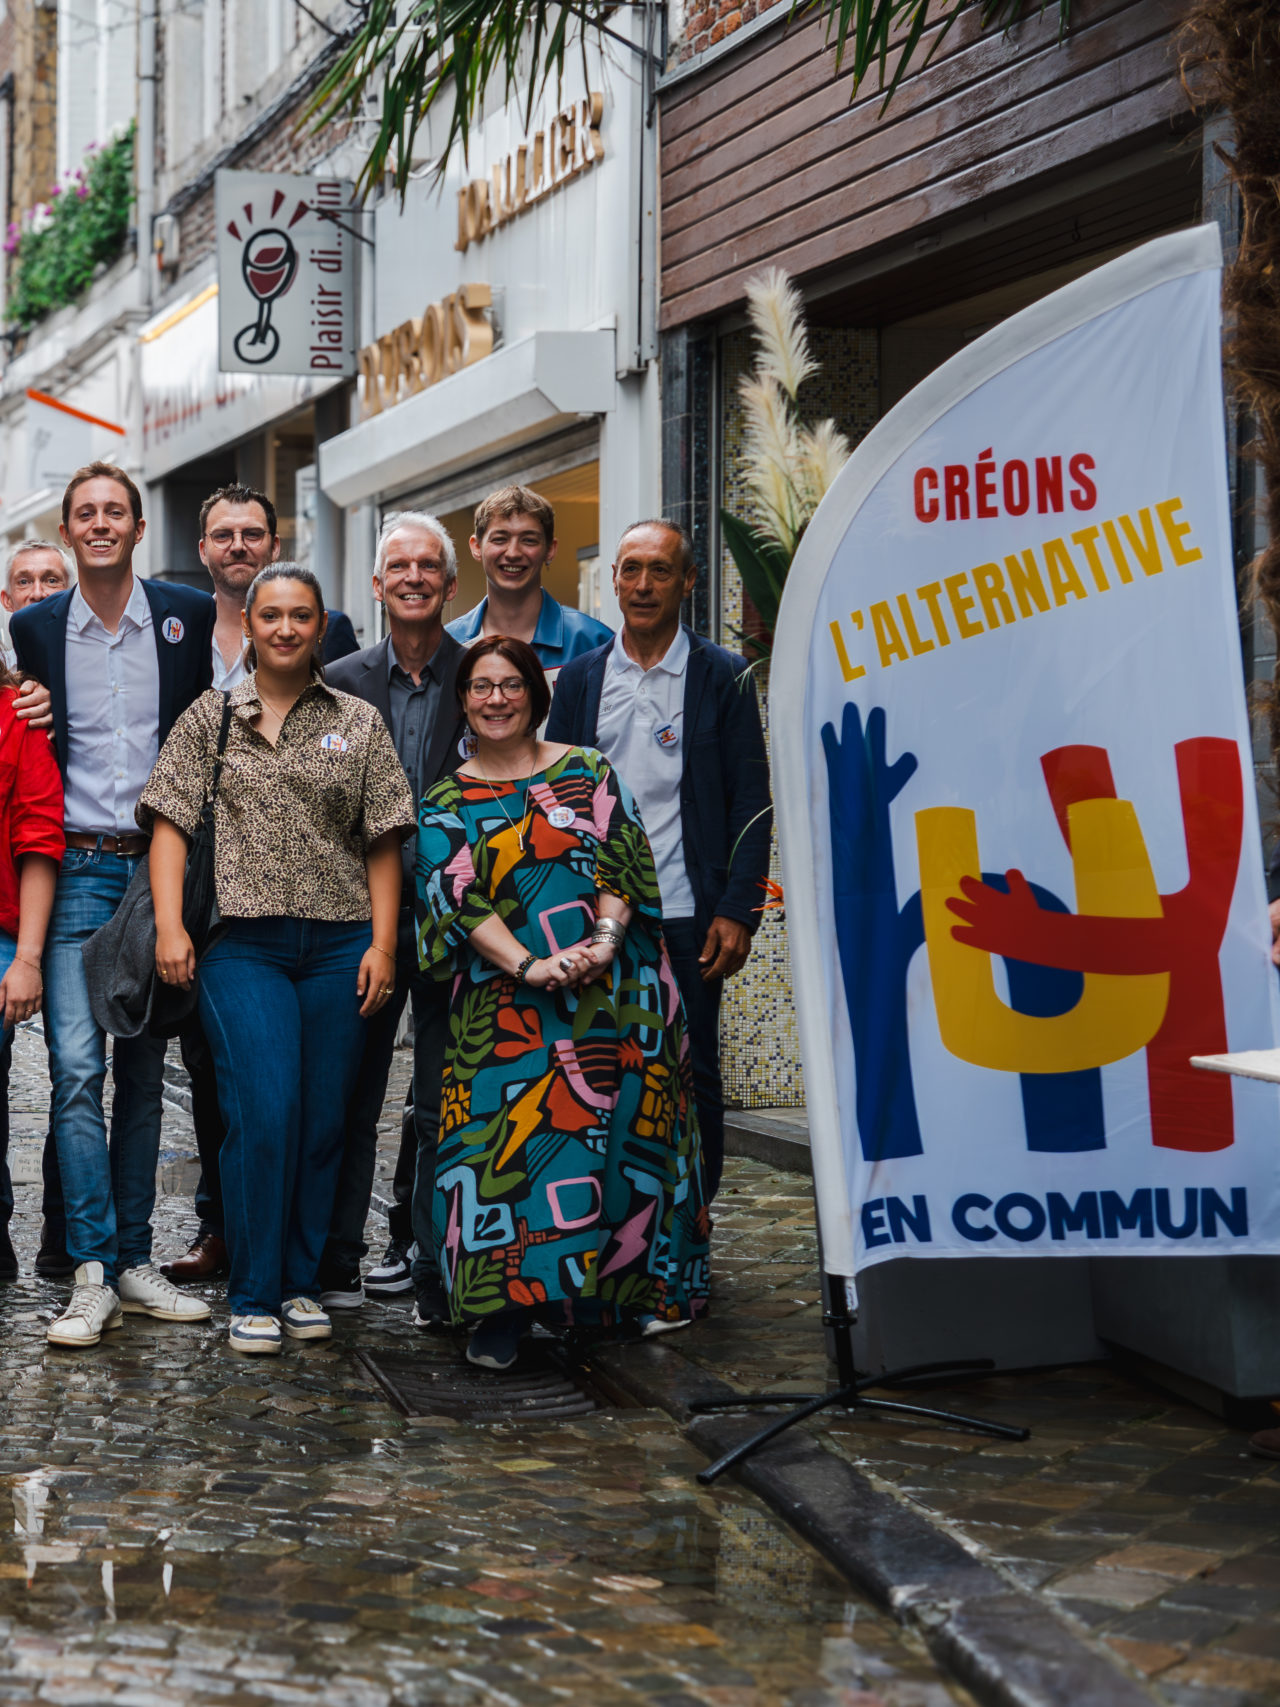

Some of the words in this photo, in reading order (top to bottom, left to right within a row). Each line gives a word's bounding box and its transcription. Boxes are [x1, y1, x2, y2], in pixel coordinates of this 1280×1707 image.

[310, 284, 343, 369] Plaisir
[913, 446, 1098, 524] CRÉONS
[829, 497, 1203, 683] L'ALTERNATIVE
[860, 1194, 933, 1250] EN
[952, 1186, 1250, 1243] COMMUN
